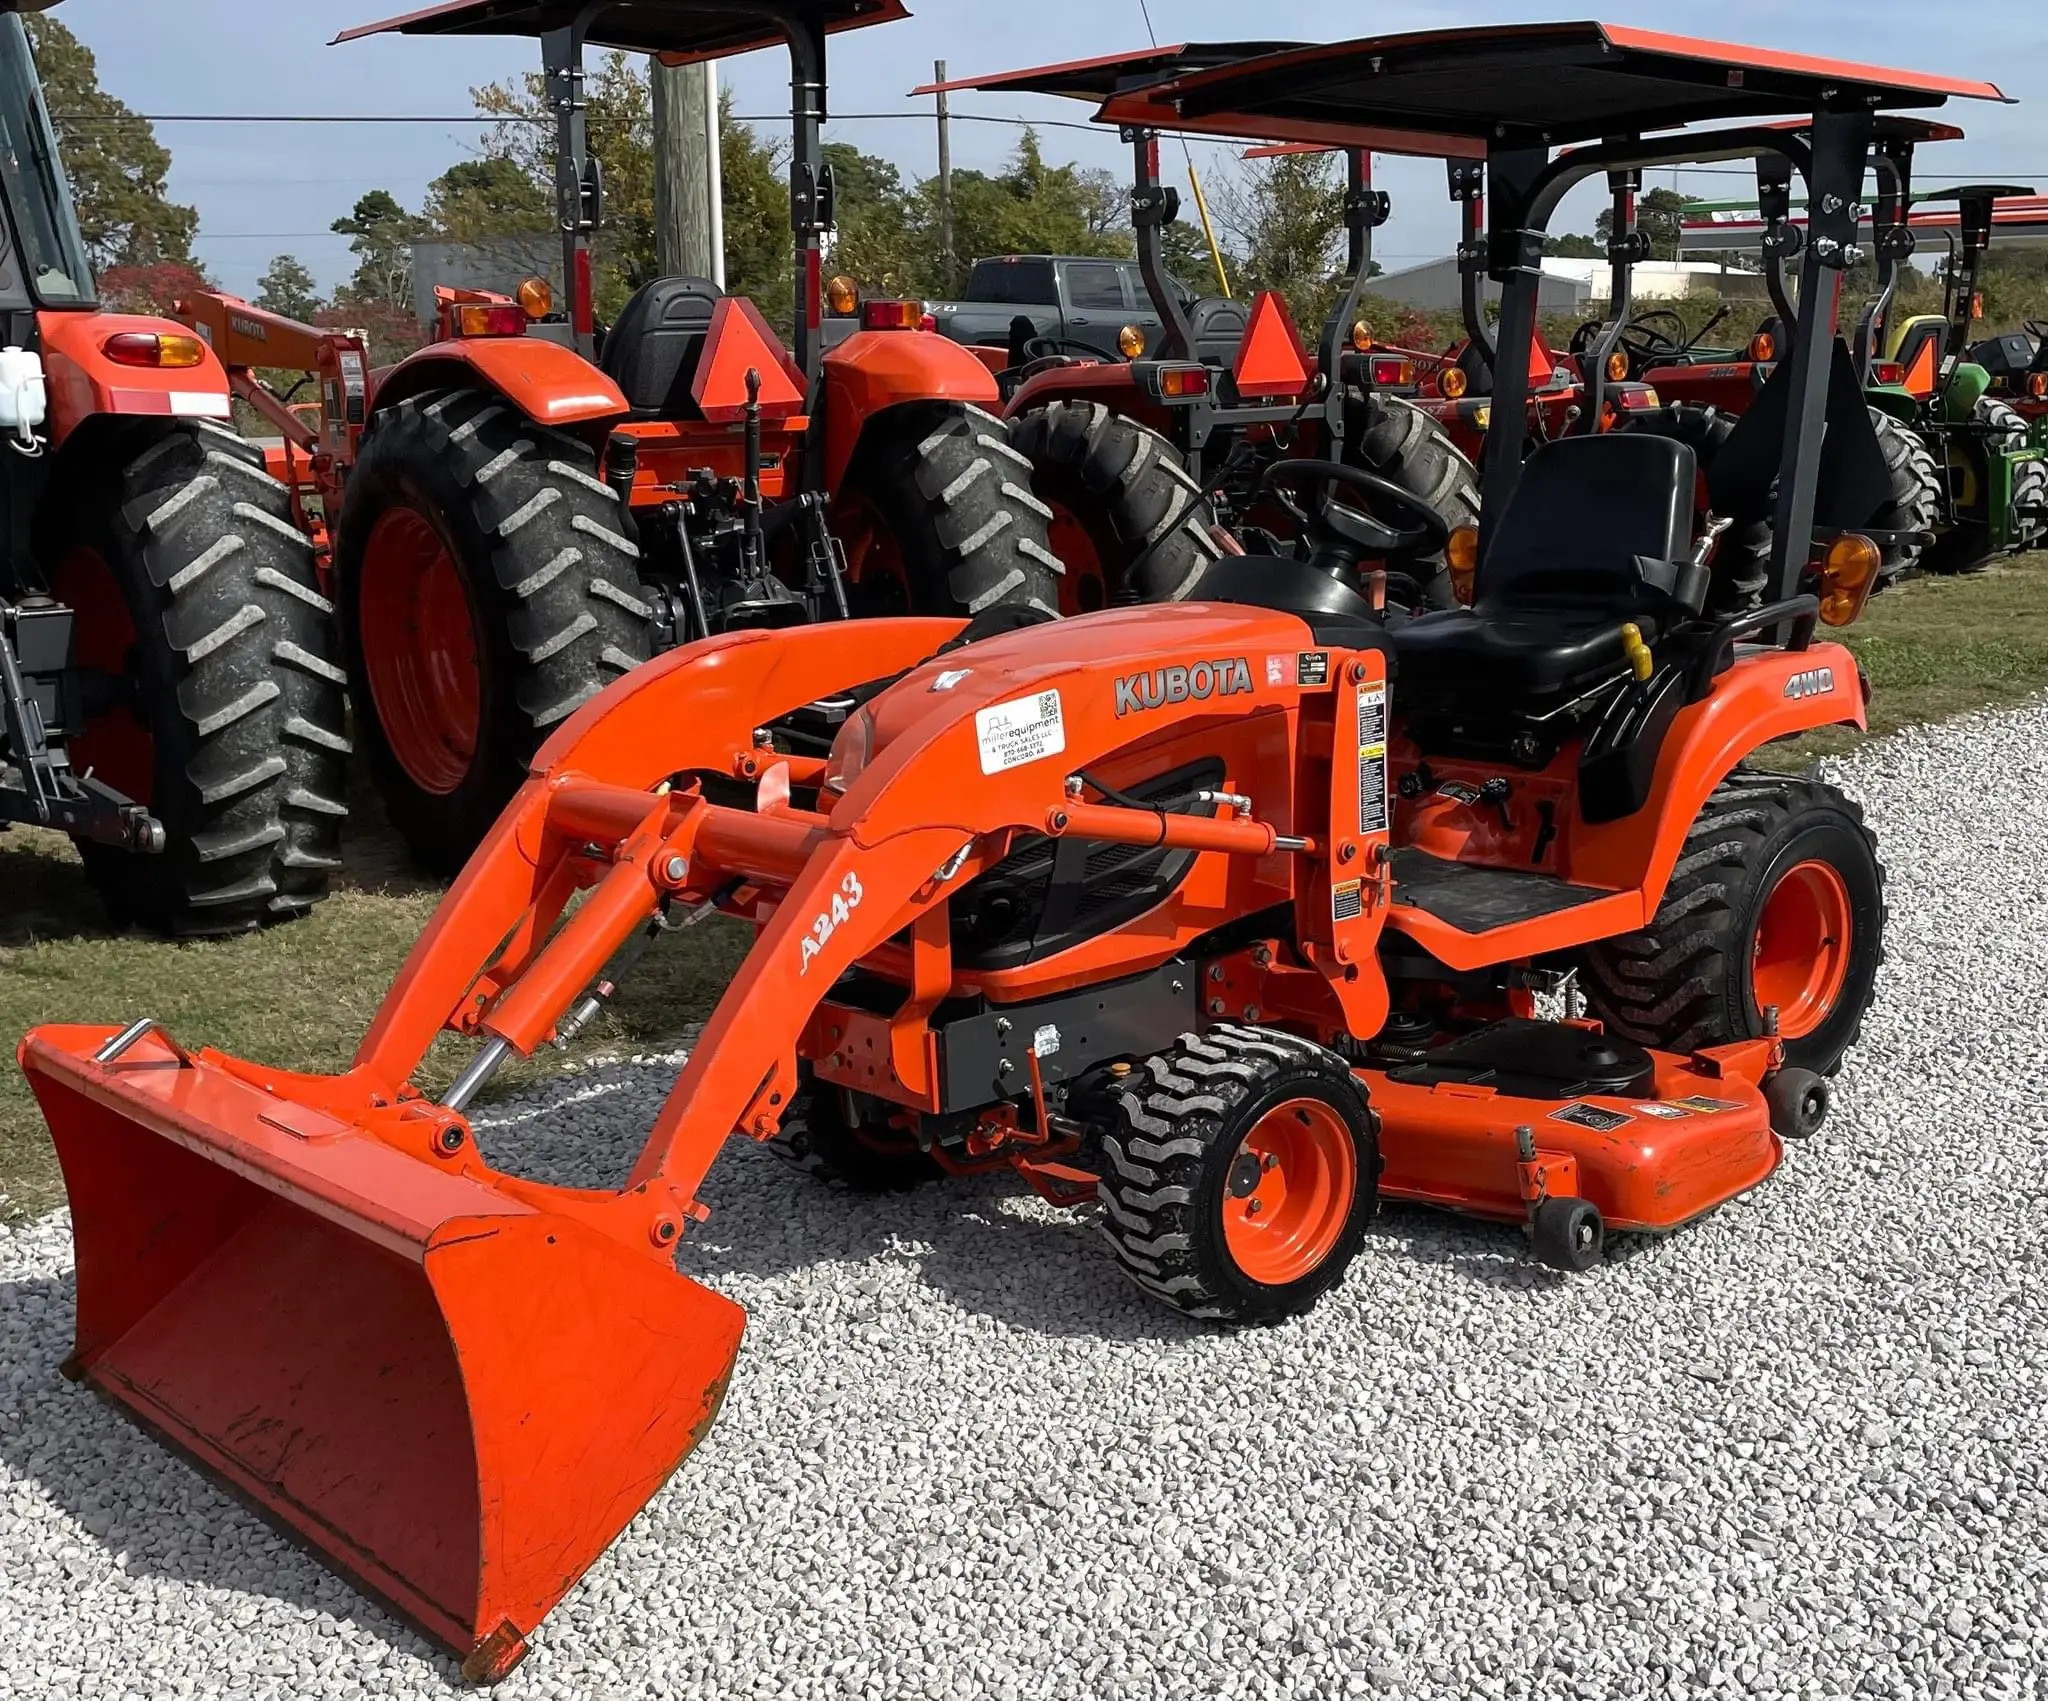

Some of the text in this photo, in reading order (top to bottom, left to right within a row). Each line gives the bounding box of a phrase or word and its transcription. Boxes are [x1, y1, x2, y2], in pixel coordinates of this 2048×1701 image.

[231, 315, 267, 339] KUBOTA
[1114, 657, 1254, 717] KUBOTA
[1784, 666, 1834, 700] 4WD
[998, 740, 1019, 751] TRUCK
[1020, 733, 1040, 744] SALES
[1041, 730, 1053, 738] LLC
[1036, 747, 1045, 755] AR
[800, 871, 863, 977] A243
